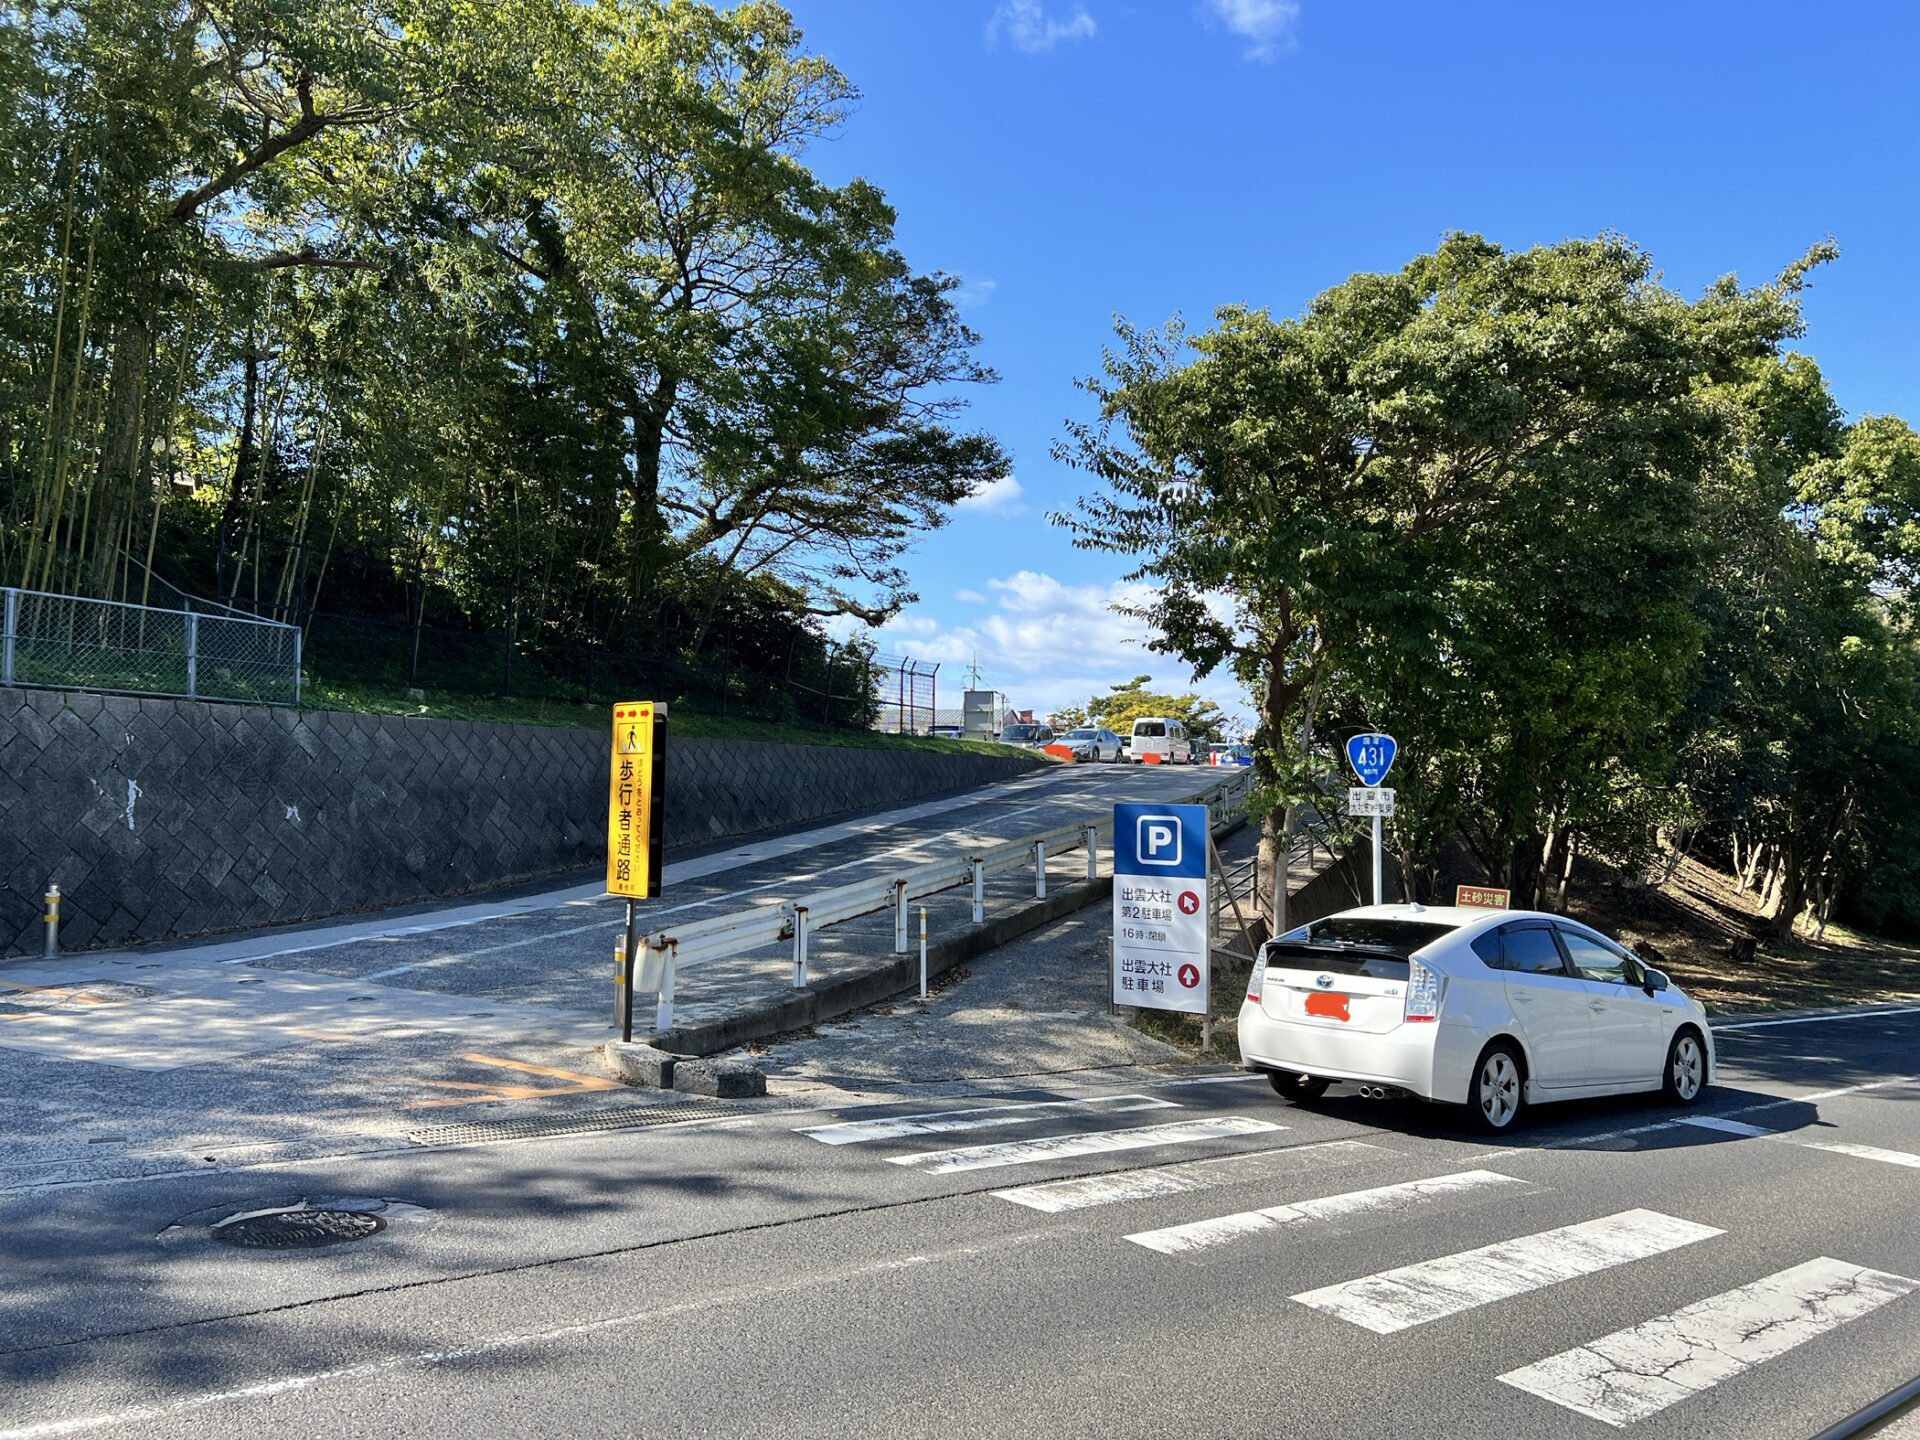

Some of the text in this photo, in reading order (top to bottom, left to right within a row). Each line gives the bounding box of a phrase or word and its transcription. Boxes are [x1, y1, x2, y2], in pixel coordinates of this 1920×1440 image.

[1358, 747, 1384, 766] 431
[1352, 791, 1390, 801] 出雲市
[616, 759, 633, 881] 歩行者通路
[1148, 826, 1172, 855] P
[1122, 887, 1172, 903] 出雲大社
[1461, 891, 1504, 905] 土砂災害
[1122, 906, 1172, 922] 第2駐車場
[1122, 959, 1172, 977] 出雲大社
[1122, 977, 1164, 994] 駐車場
